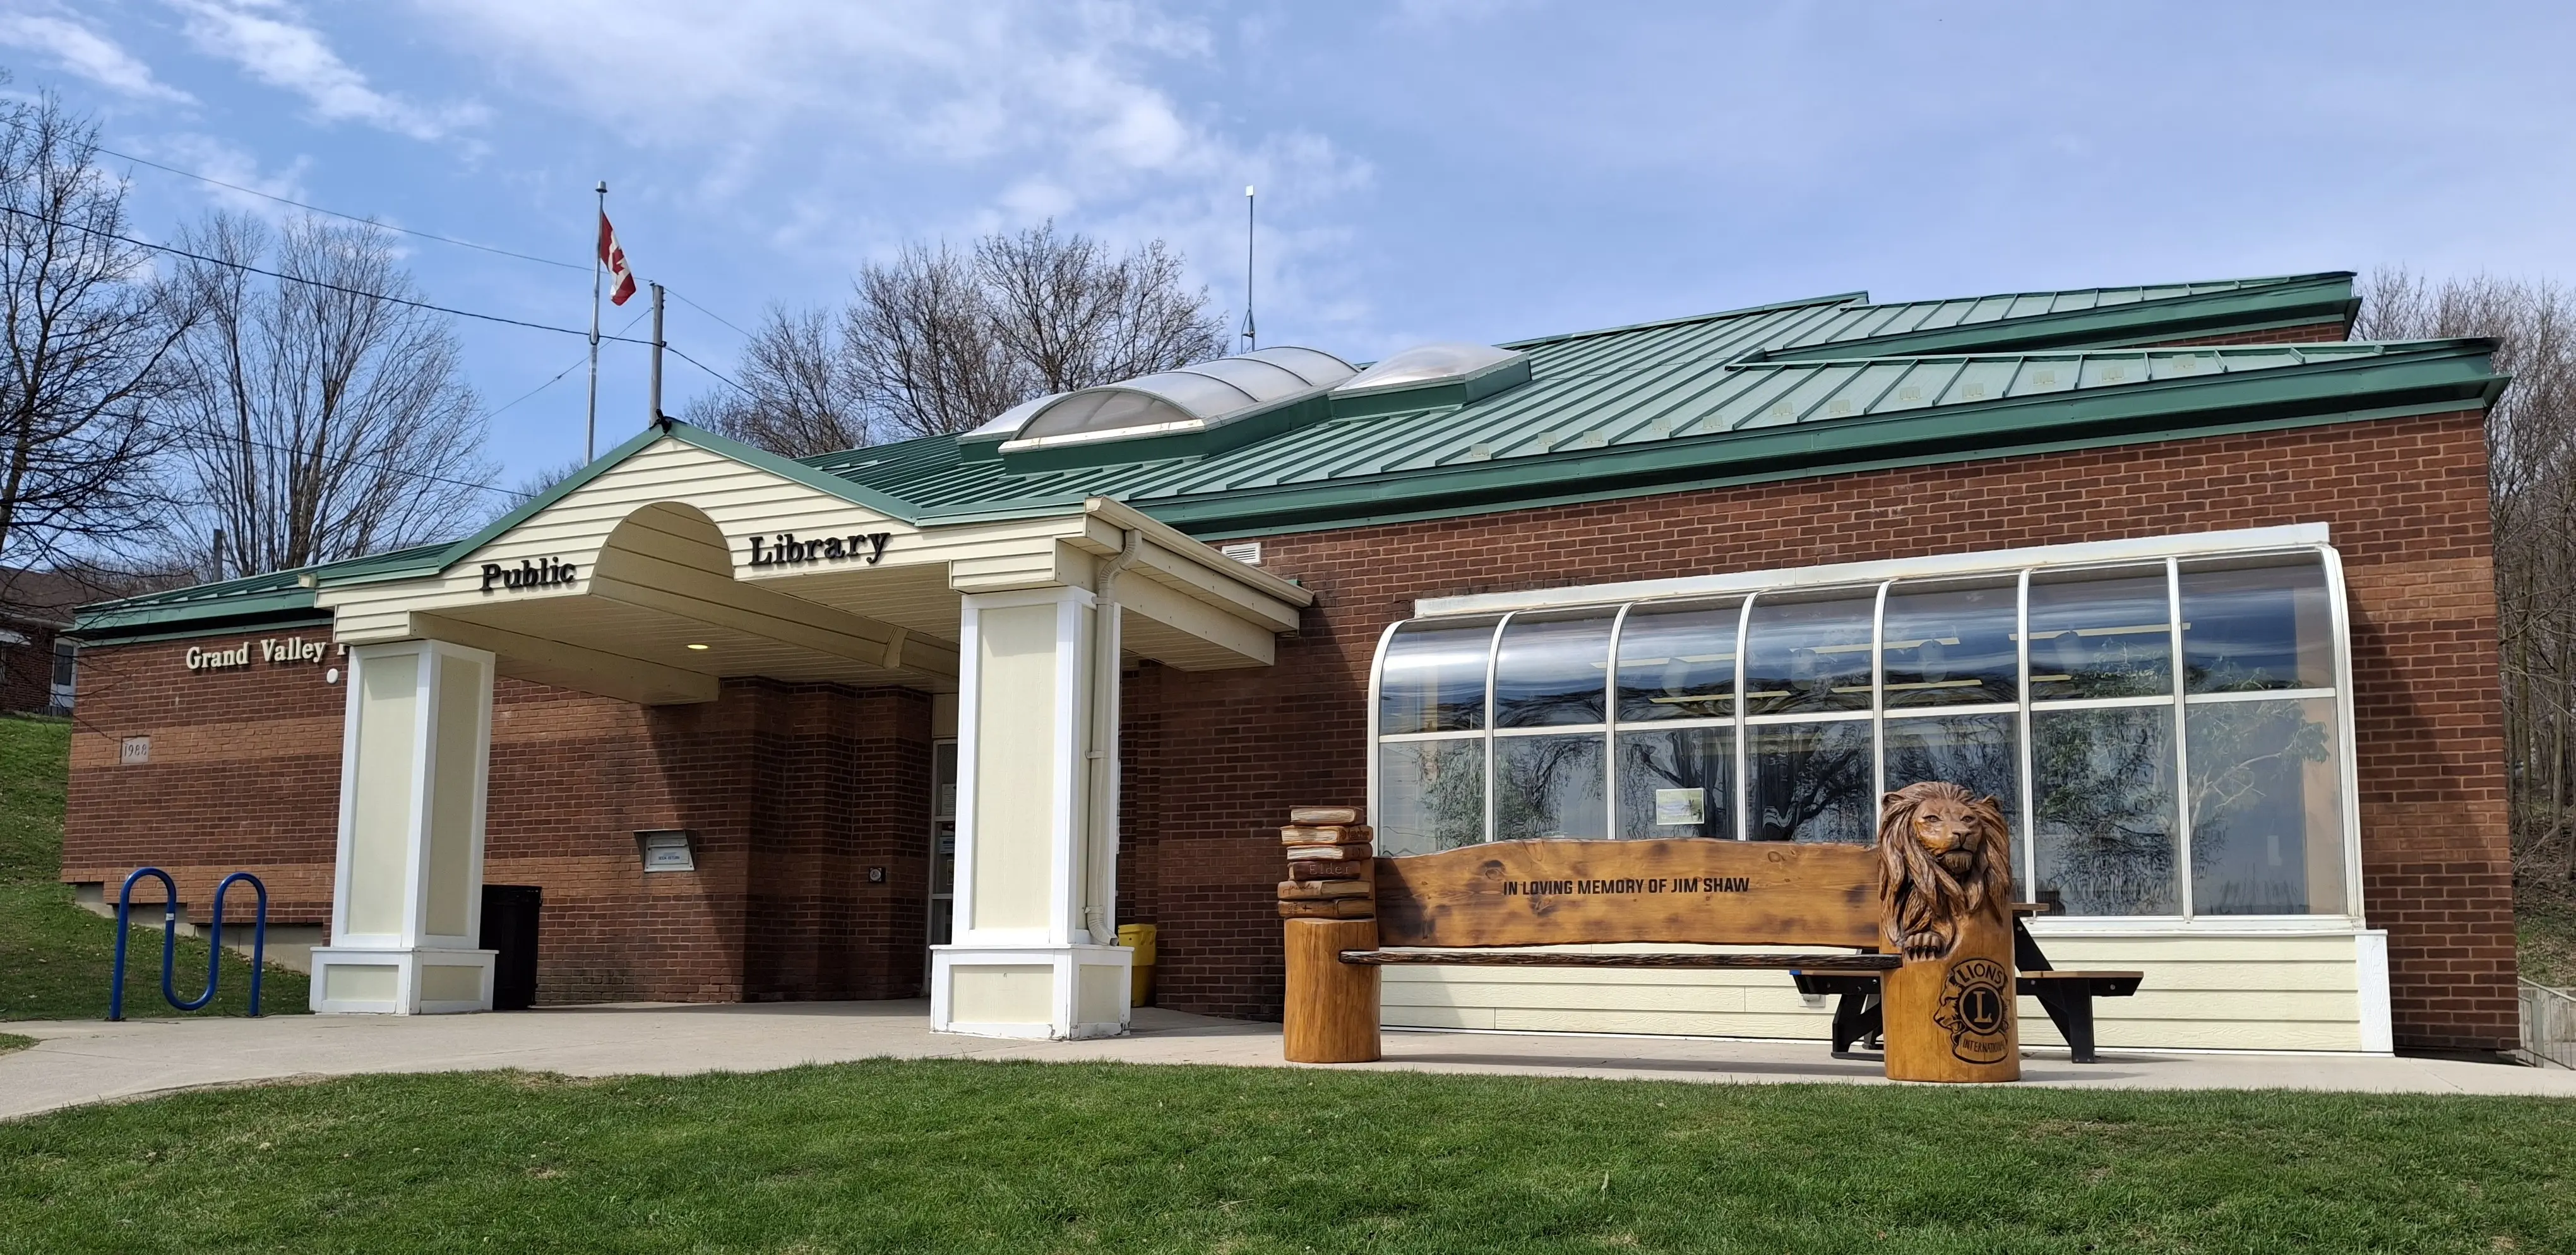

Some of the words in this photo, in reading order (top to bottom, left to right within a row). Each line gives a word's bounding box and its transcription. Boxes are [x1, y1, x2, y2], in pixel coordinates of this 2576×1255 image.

[480, 556, 577, 592] Public
[748, 531, 891, 567] Library
[186, 641, 250, 670] Grand
[260, 636, 327, 663] Valley
[124, 744, 147, 758] 1988
[1309, 862, 1353, 875] Elder
[1503, 881, 1518, 895] IN
[1522, 880, 1573, 895] LOVING
[1578, 879, 1644, 895] MEMORY
[1649, 878, 1667, 893] OF
[1671, 878, 1698, 893] JIM
[1703, 877, 1750, 892] SHAW
[1957, 963, 2003, 985] LIONS
[1973, 990, 1993, 1023] L
